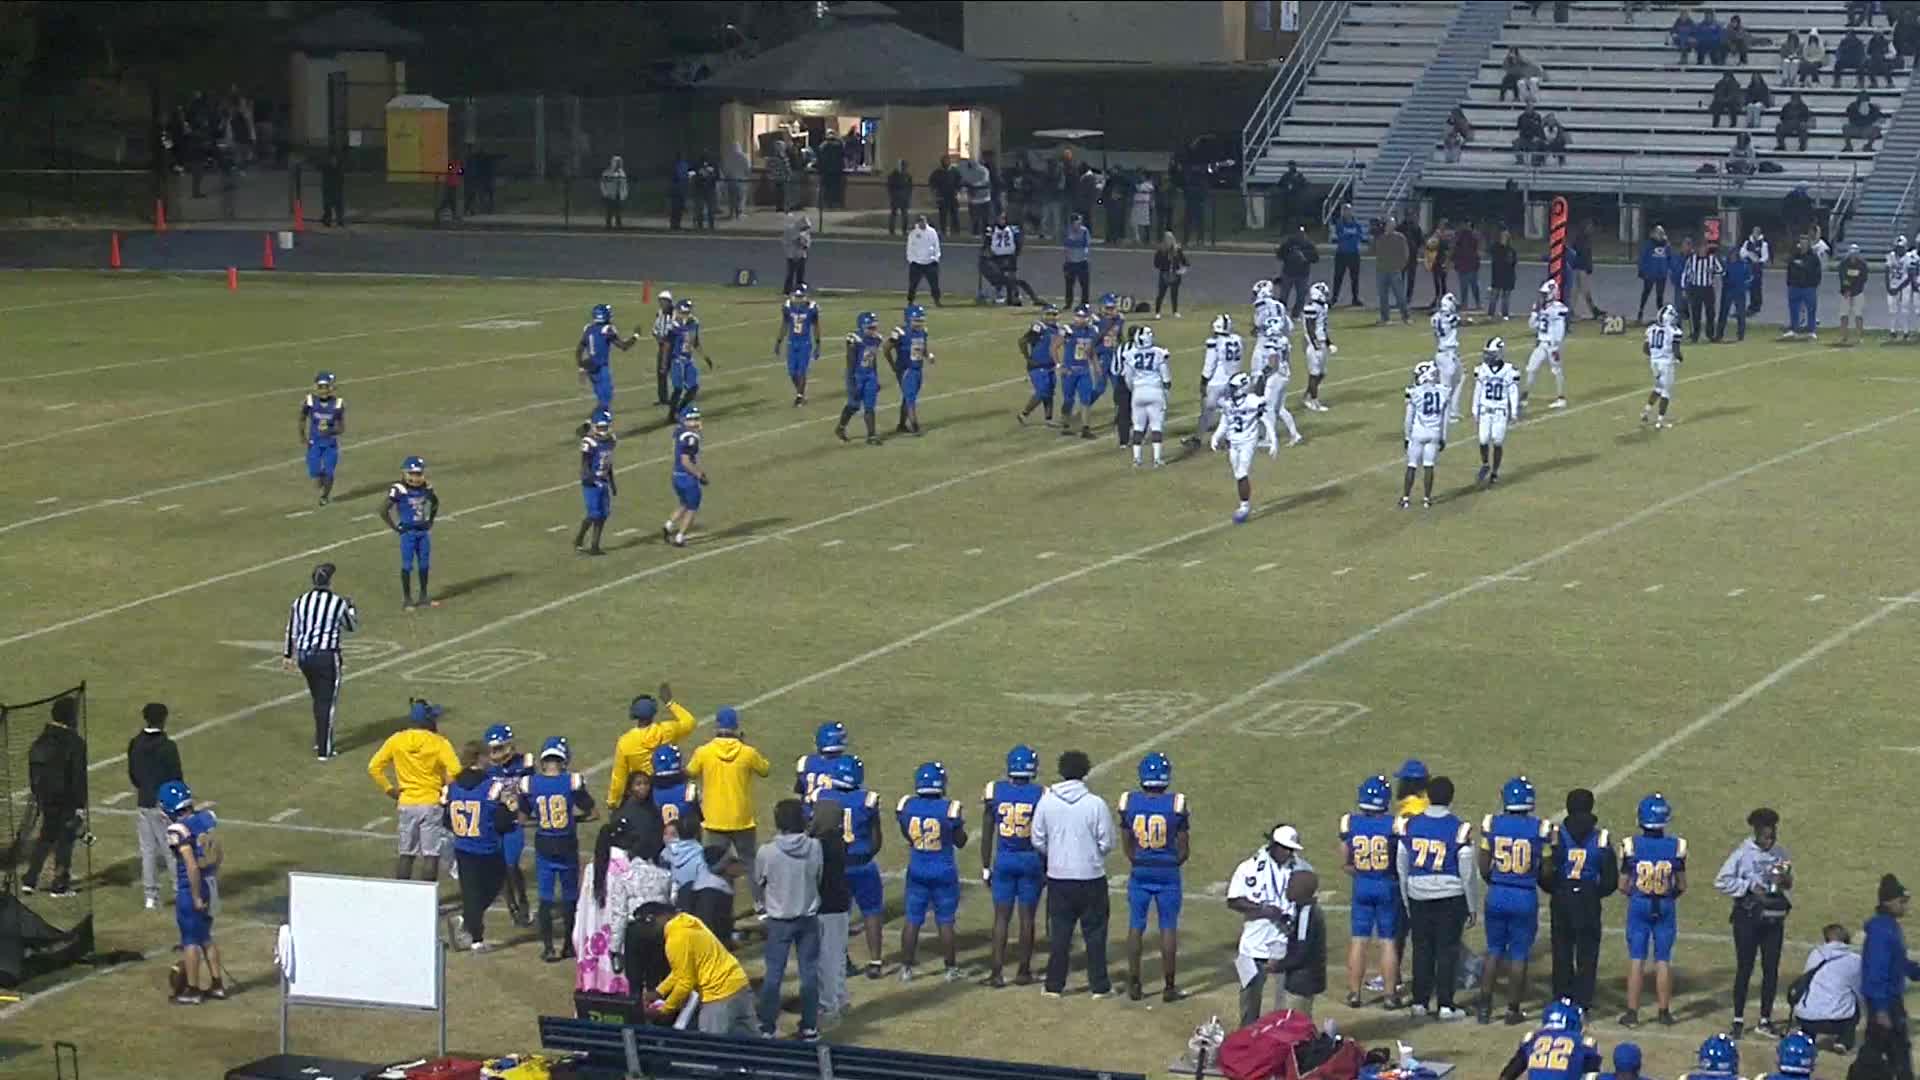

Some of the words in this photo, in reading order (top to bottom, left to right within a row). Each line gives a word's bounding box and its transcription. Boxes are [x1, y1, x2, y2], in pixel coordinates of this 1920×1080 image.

[1604, 317, 1625, 334] 20
[1651, 329, 1665, 350] 10
[1134, 352, 1156, 371] 27
[1225, 342, 1242, 362] 62
[1423, 391, 1441, 415] 21
[1485, 383, 1503, 401] 20
[1232, 415, 1244, 434] 3
[449, 800, 481, 837] 67
[536, 794, 569, 830] 18
[998, 802, 1032, 839] 35
[908, 816, 941, 850] 42
[1132, 814, 1168, 849] 40
[1412, 838, 1446, 872] 77
[1493, 836, 1532, 875] 50
[1567, 848, 1587, 879] 7
[1528, 1036, 1574, 1070] 22
